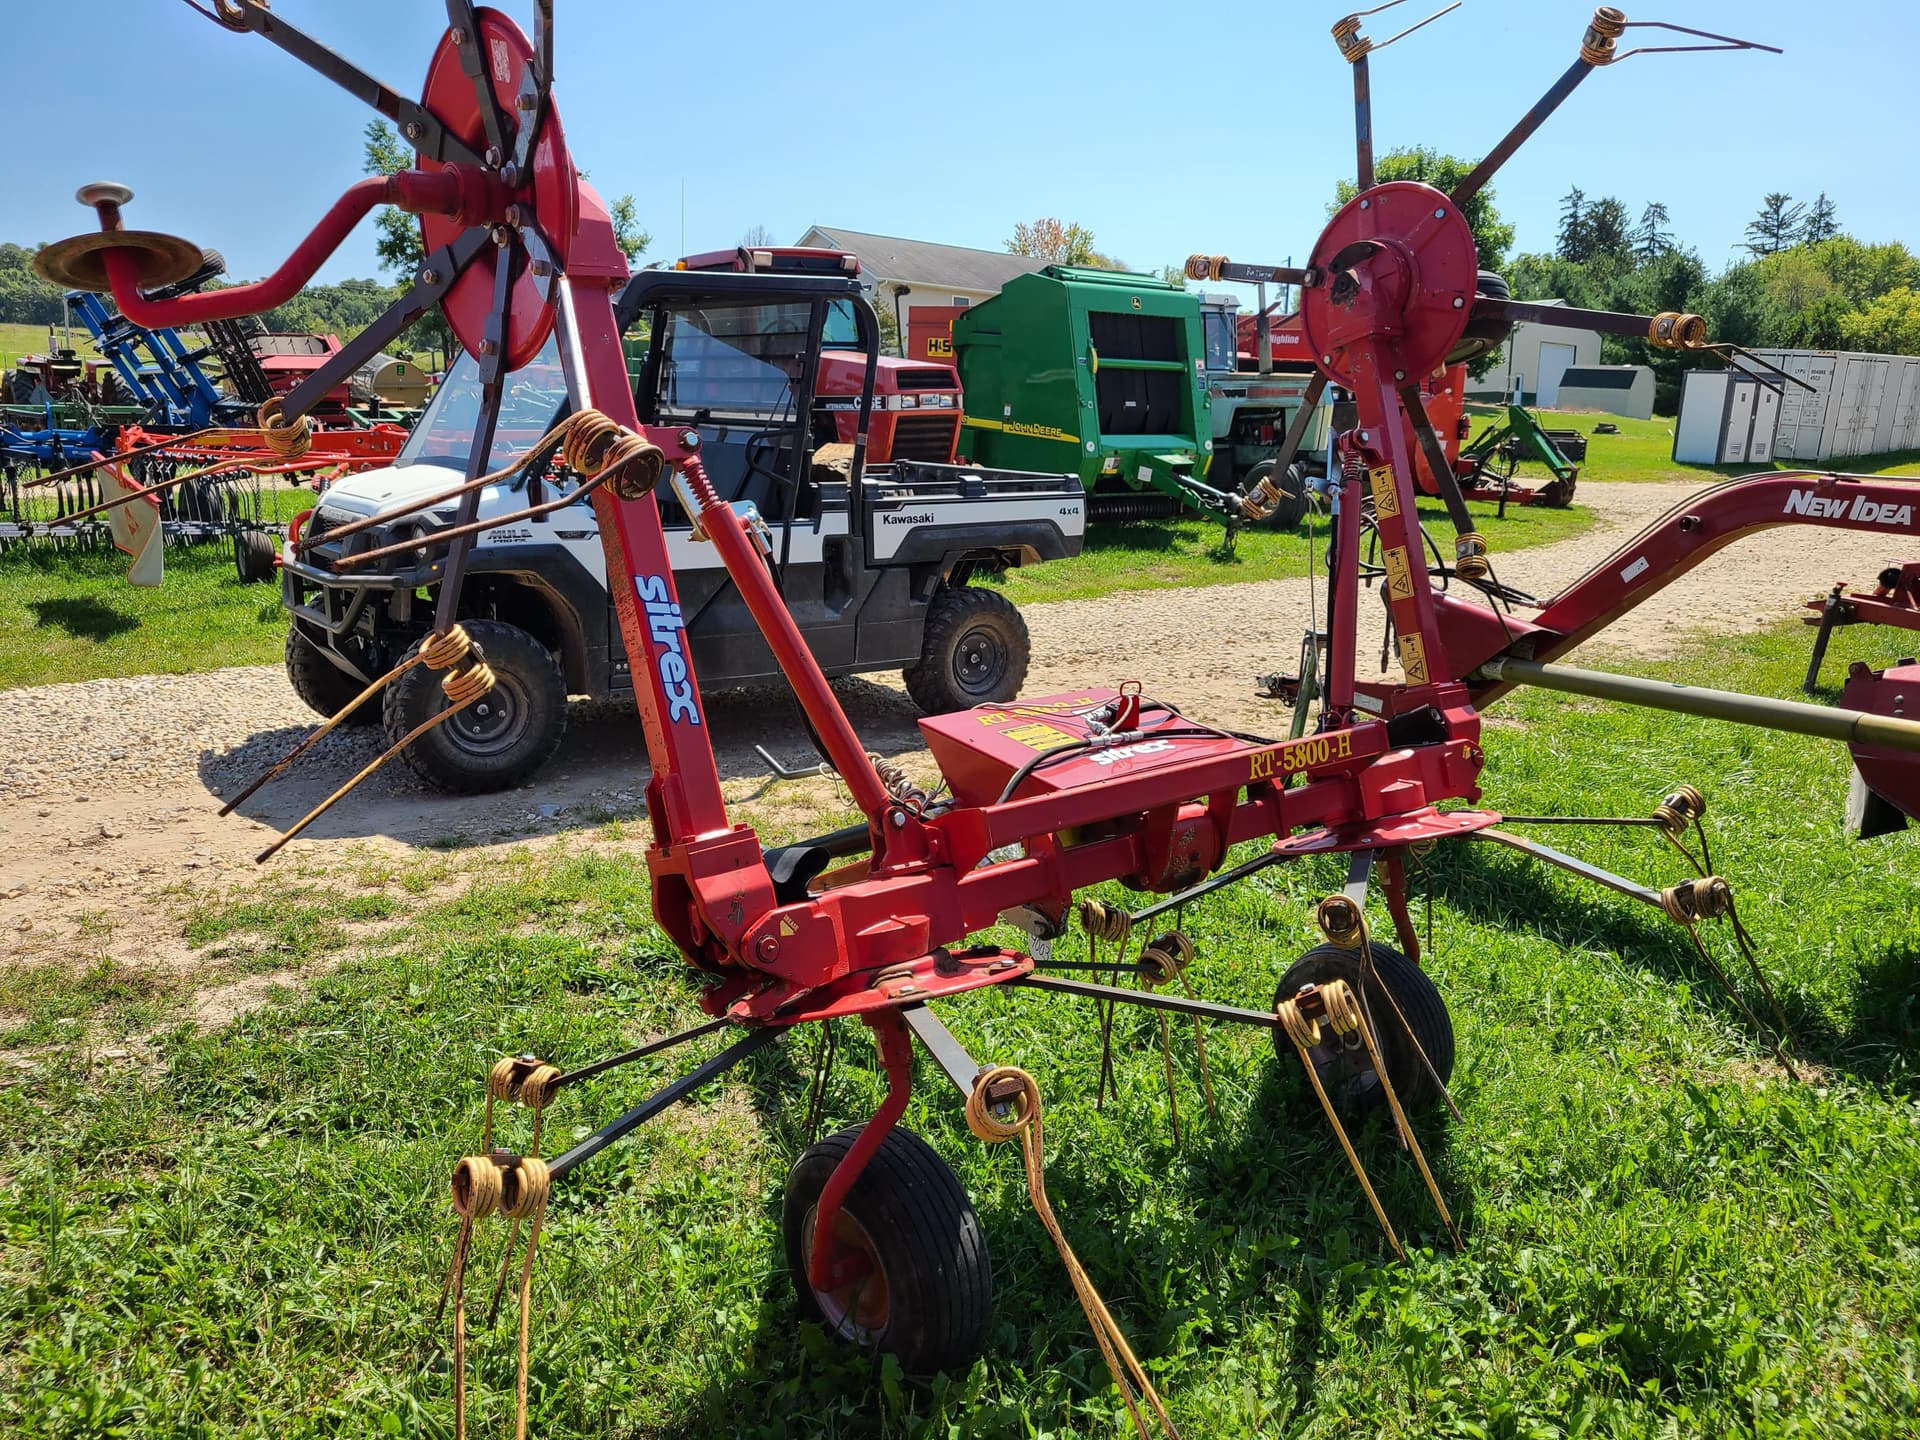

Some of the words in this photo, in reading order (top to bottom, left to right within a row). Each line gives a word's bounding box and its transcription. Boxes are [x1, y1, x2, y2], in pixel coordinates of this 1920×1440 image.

[853, 397, 882, 409] CSE
[1009, 421, 1033, 433] JOHN
[1033, 423, 1062, 438] DEERE
[1059, 506, 1080, 516] 4x4
[1783, 489, 1850, 519] NEW
[1848, 495, 1911, 525] IDEA
[883, 513, 934, 525] Kawasaki
[634, 575, 701, 725] sitrex
[1089, 739, 1177, 765] sitrex
[1249, 732, 1353, 780] RT-5800-H
